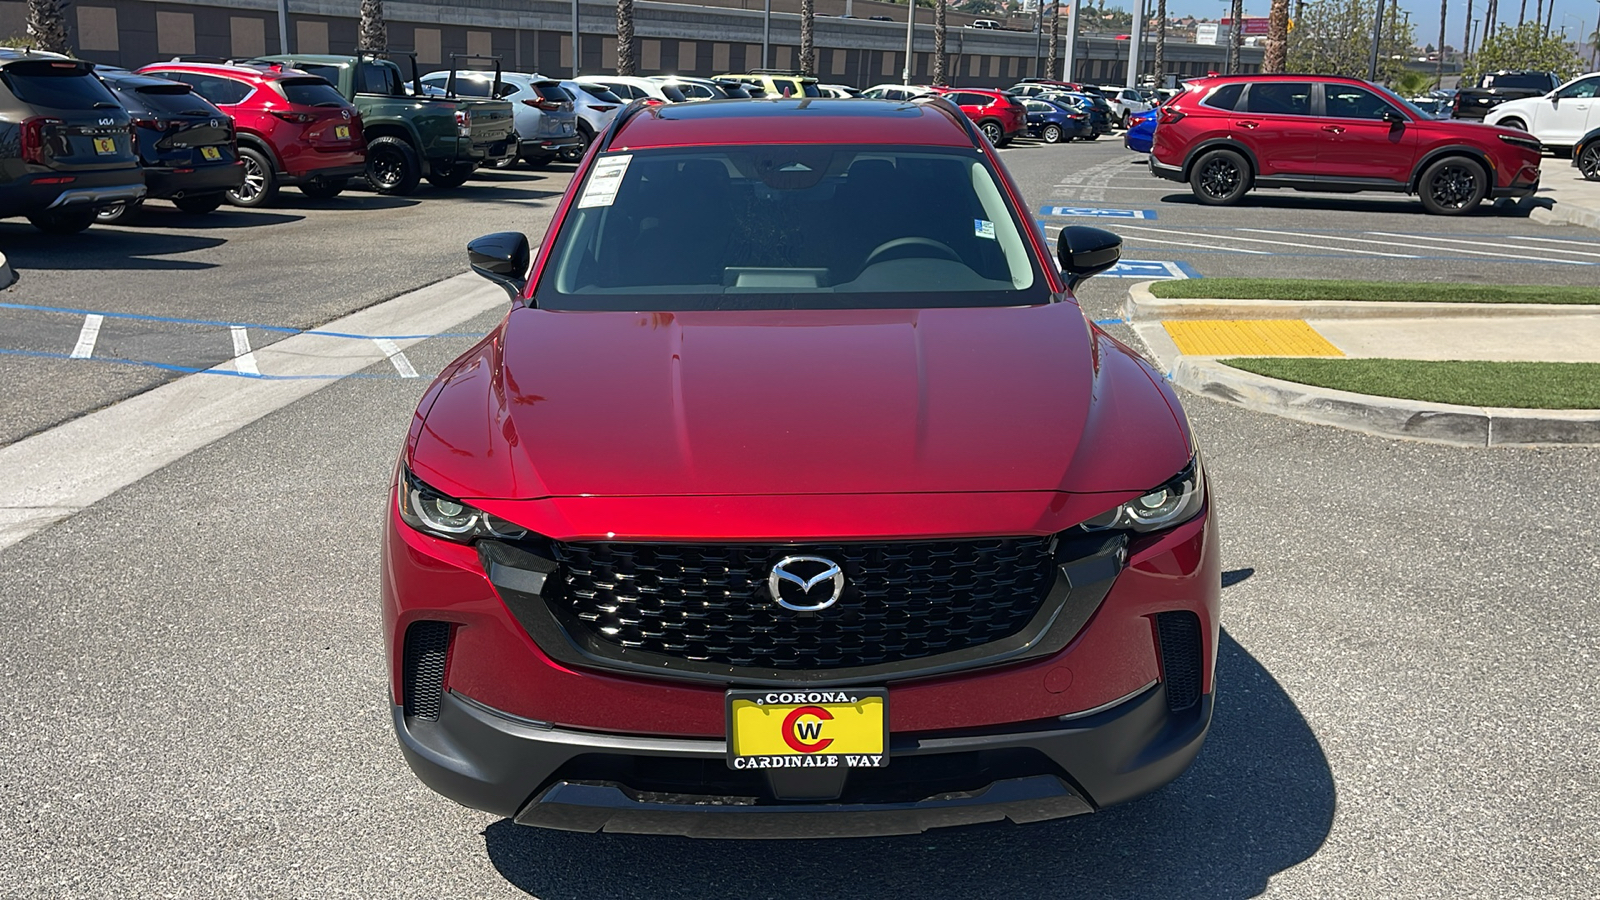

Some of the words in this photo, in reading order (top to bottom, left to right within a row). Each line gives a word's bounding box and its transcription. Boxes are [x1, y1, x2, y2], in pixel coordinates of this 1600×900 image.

[98, 118, 114, 126] KIA
[765, 692, 850, 704] CORONA
[781, 705, 835, 753] C
[797, 721, 823, 740] W
[733, 755, 839, 769] CARDINALE
[845, 755, 883, 768] WAY
